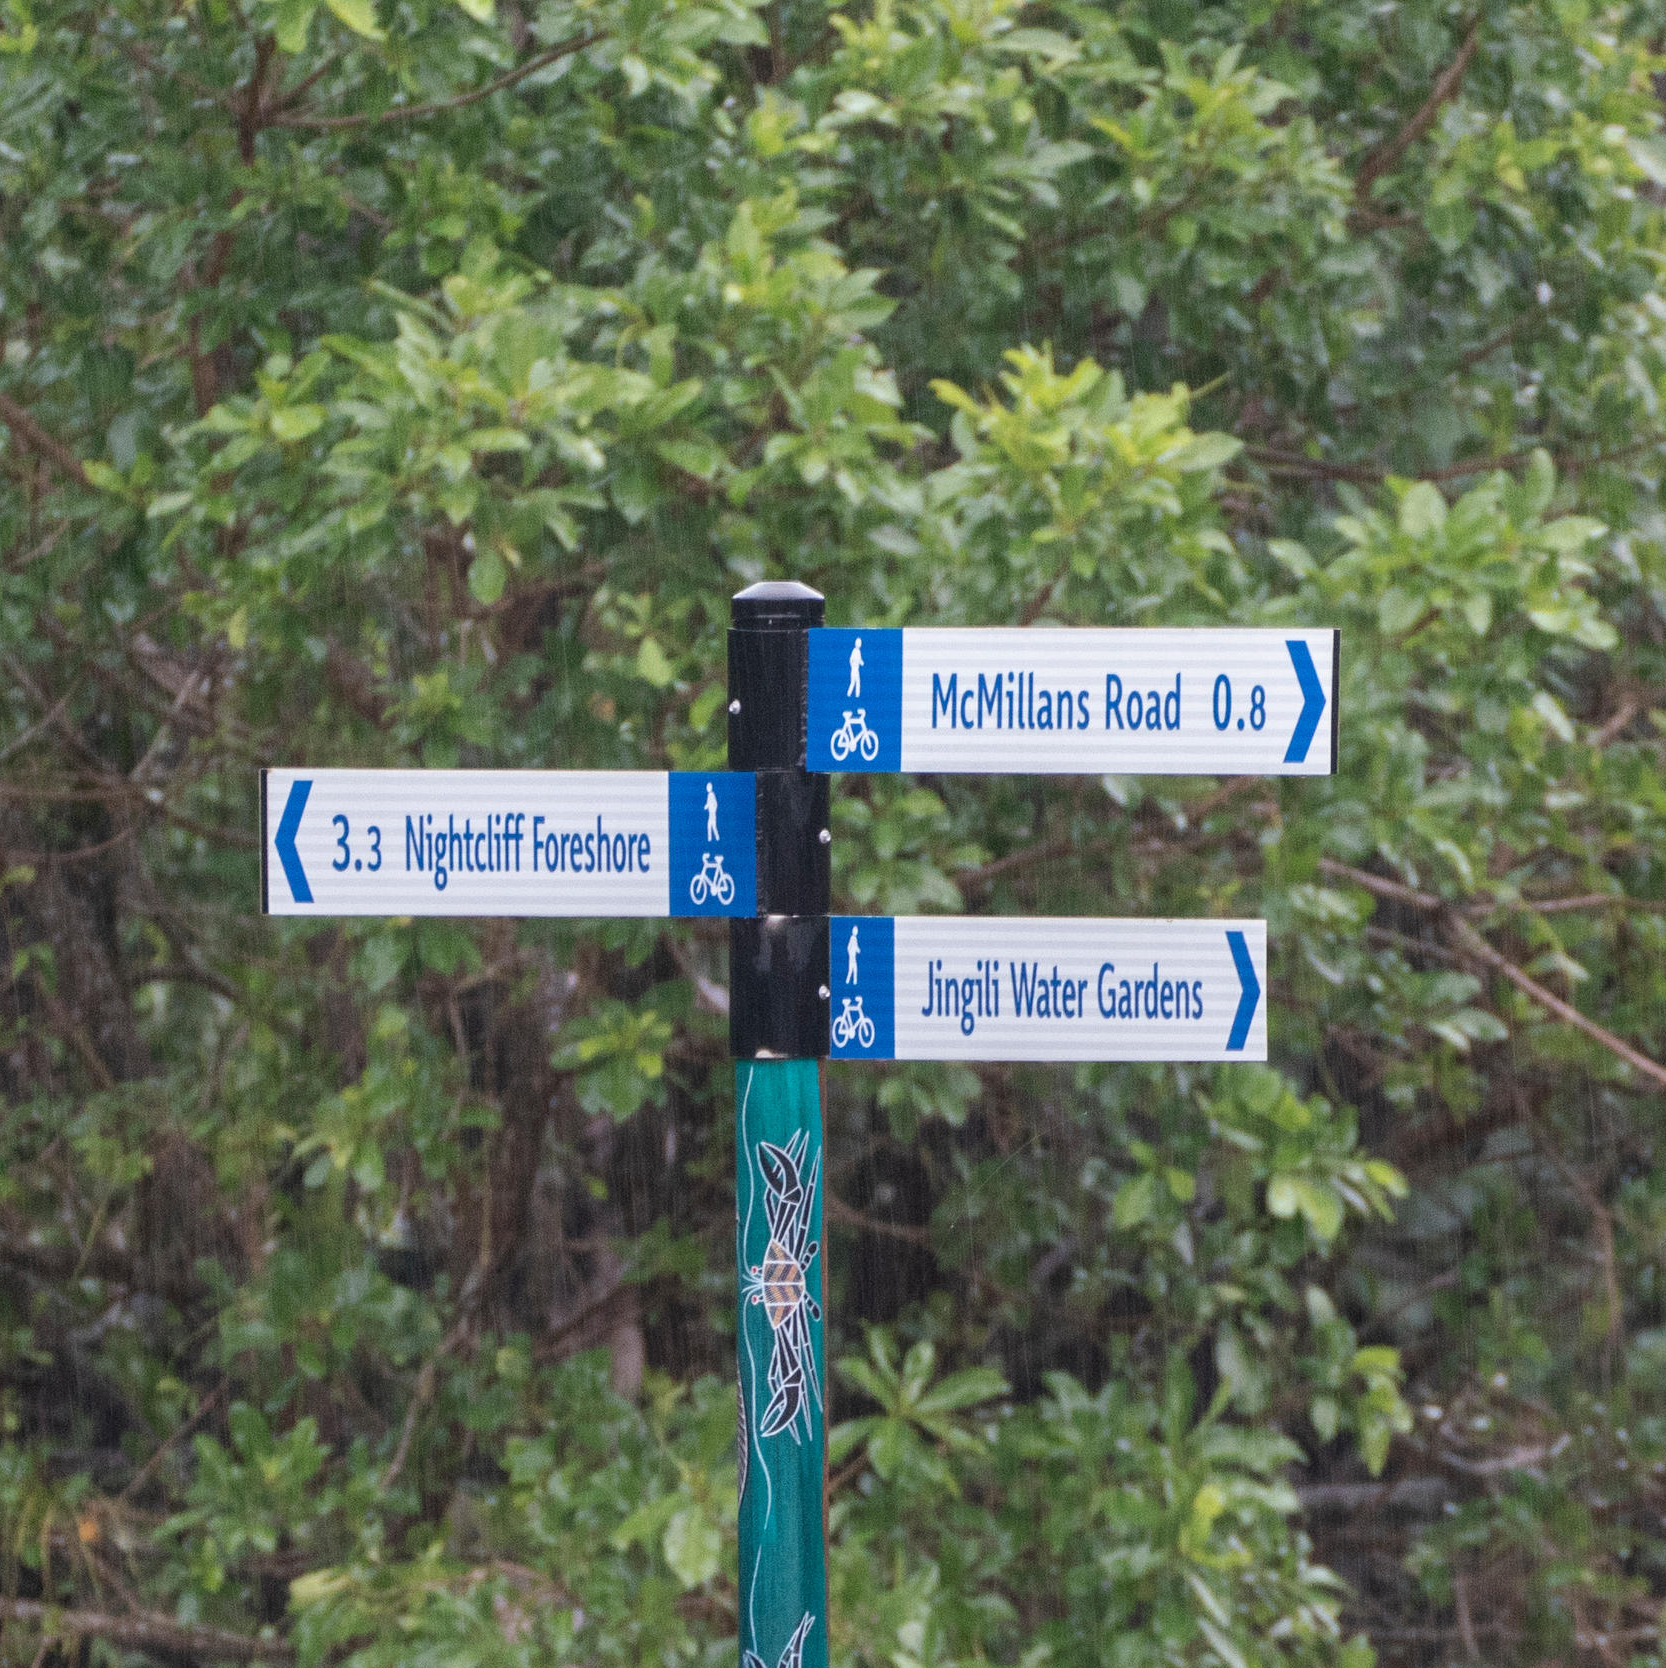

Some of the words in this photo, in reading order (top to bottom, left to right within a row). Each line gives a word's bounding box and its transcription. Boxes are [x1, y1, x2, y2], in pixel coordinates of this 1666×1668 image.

[931, 671, 1090, 730] McMillans
[1105, 673, 1181, 731] Road
[1212, 673, 1266, 732] 0.8
[332, 813, 382, 872] 3.3
[405, 812, 526, 891] Nightcliff
[533, 814, 651, 873] Foreshore
[921, 959, 1000, 1037] Jingili
[1009, 961, 1089, 1019] Water
[1097, 961, 1203, 1020] Gardens
